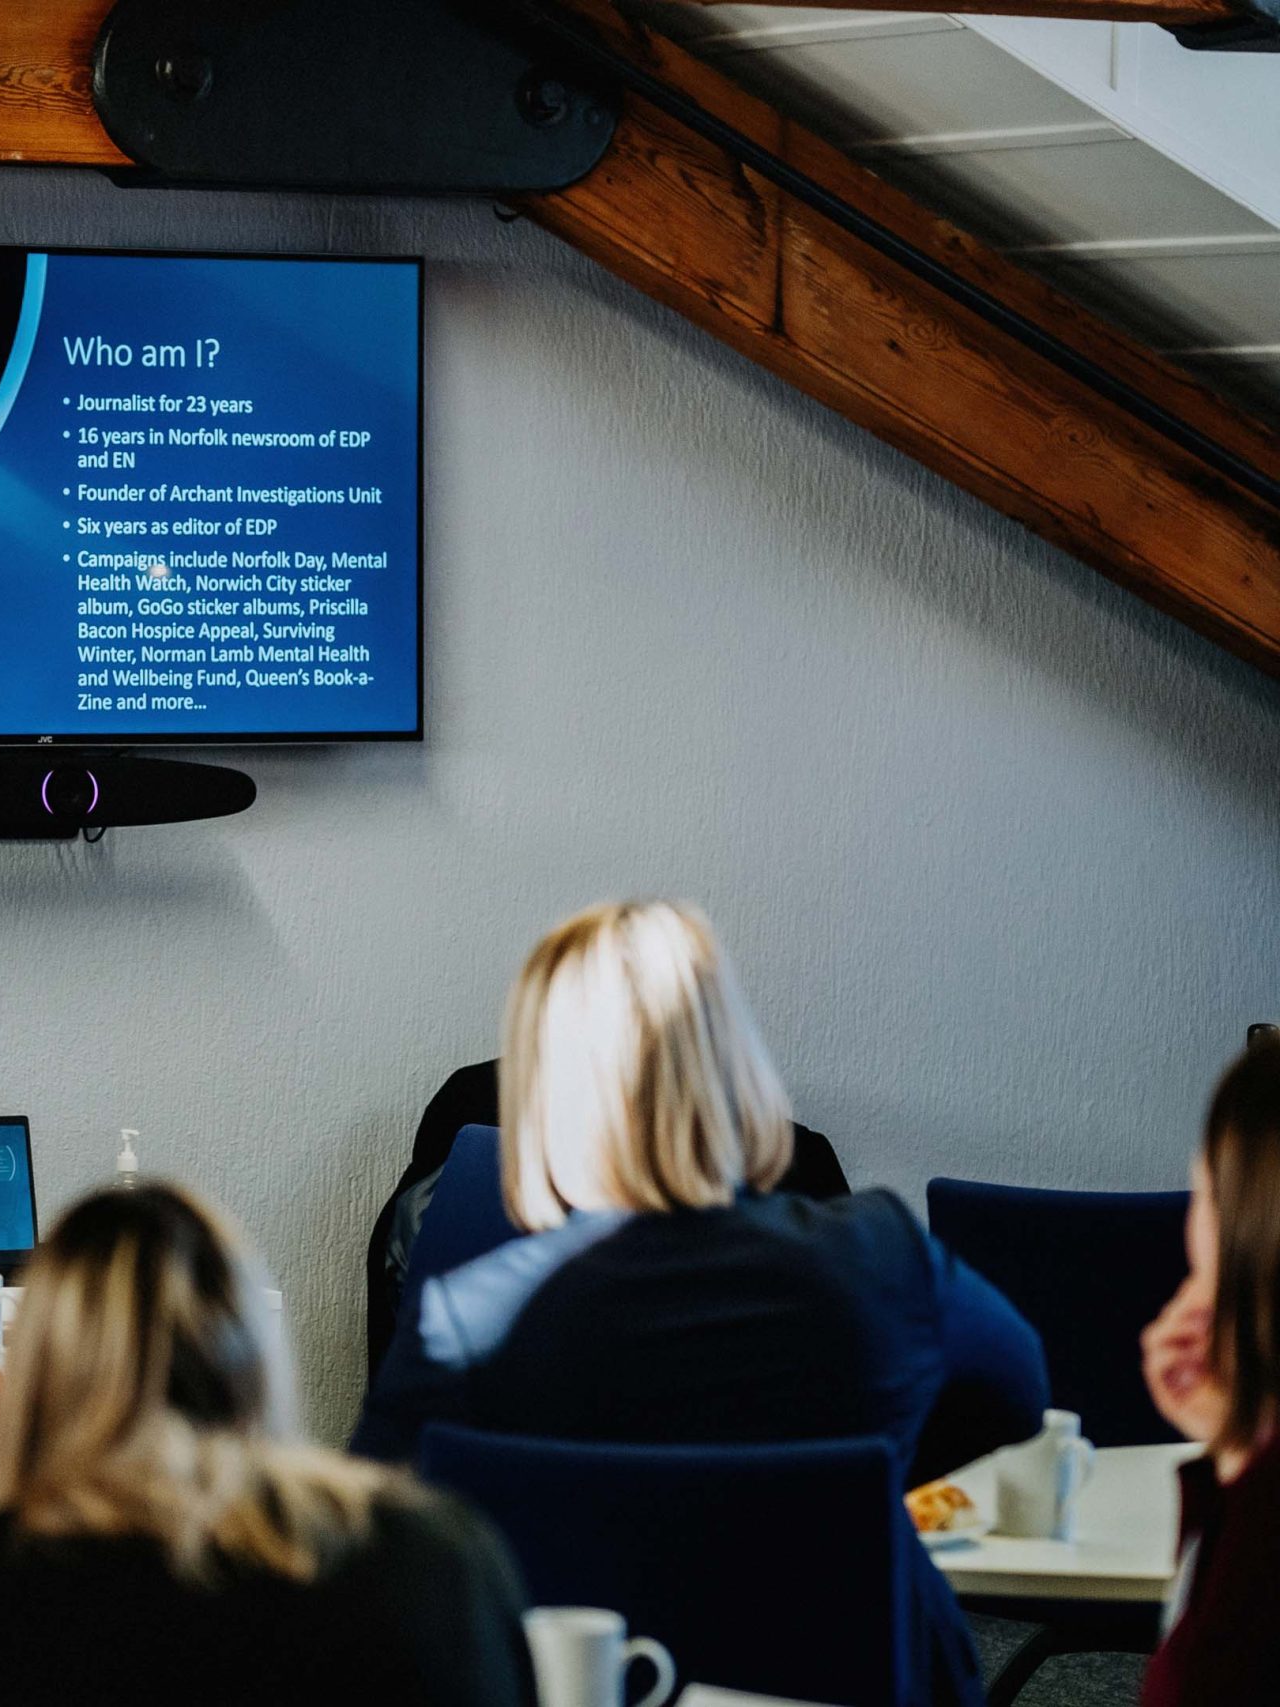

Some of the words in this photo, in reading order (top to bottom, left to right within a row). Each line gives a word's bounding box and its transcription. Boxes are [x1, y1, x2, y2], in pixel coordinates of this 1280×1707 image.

[63, 335, 133, 366] Who
[141, 345, 186, 367] am
[196, 338, 220, 368] I?
[77, 394, 156, 412] Journalist
[158, 394, 183, 412] for
[186, 395, 207, 413] 23
[210, 399, 253, 417] years
[78, 427, 99, 444] 16
[101, 431, 146, 448] years
[149, 428, 164, 445] in
[168, 428, 228, 446] Norfolk
[231, 432, 315, 447] newsroom
[318, 429, 337, 448] of
[339, 430, 371, 448] EDP
[77, 450, 109, 469] and
[112, 451, 135, 469] EN
[78, 483, 146, 502] Founder
[149, 483, 168, 502] of
[169, 484, 233, 503] Archant
[237, 486, 345, 507] Investigations
[348, 487, 382, 504] Unit
[77, 517, 101, 535] Six
[103, 521, 148, 538] years
[150, 521, 169, 535] as
[172, 517, 222, 536] editor
[224, 517, 243, 536] of
[245, 518, 278, 536] EDP
[77, 550, 166, 571] Campaigns
[169, 550, 228, 569] include
[231, 550, 291, 569] Norfolk
[294, 551, 328, 572] Day,
[331, 551, 387, 569] Mental
[78, 573, 131, 592] Health
[135, 573, 192, 594] Watch,
[196, 574, 262, 592] Norwich
[266, 574, 297, 595] City
[300, 574, 352, 592] sticker
[77, 597, 134, 618] album,
[137, 598, 184, 616] GoGo
[187, 597, 240, 616] sticker
[242, 598, 305, 618] albums,
[309, 598, 368, 616] Priscilla
[78, 622, 127, 639] Bacon
[131, 622, 195, 643] Hospice
[198, 622, 259, 643] Appeal,
[263, 622, 336, 643] Surviving
[77, 645, 137, 665] Winter,
[141, 646, 206, 663] Norman
[210, 645, 254, 662] Lamb
[258, 644, 314, 663] Mental
[318, 645, 370, 662] Health
[77, 669, 109, 687] and
[112, 668, 193, 690] Wellbeing
[197, 668, 242, 689] Fund,
[313, 668, 374, 686] Book-a-
[77, 693, 113, 711] Zine
[116, 692, 147, 710] and
